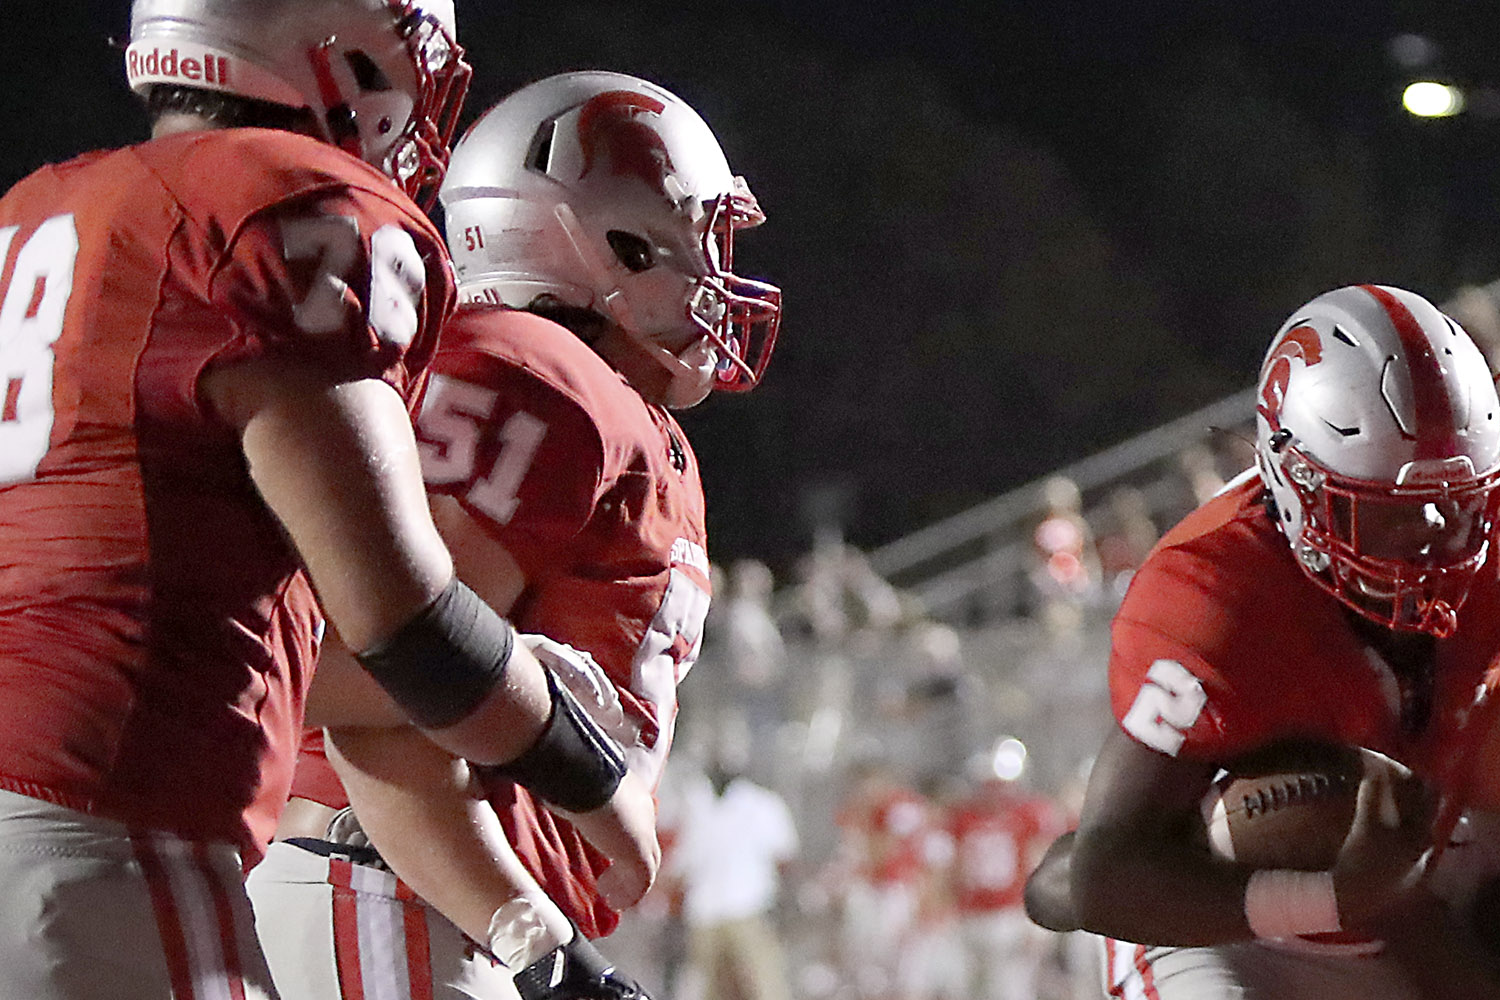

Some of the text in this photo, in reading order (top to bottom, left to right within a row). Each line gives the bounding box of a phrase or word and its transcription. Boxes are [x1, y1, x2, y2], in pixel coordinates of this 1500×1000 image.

[129, 48, 227, 85] Riddell
[464, 225, 484, 252] 51
[0, 213, 79, 484] 8
[416, 371, 549, 526] 51
[1121, 659, 1208, 758] 2
